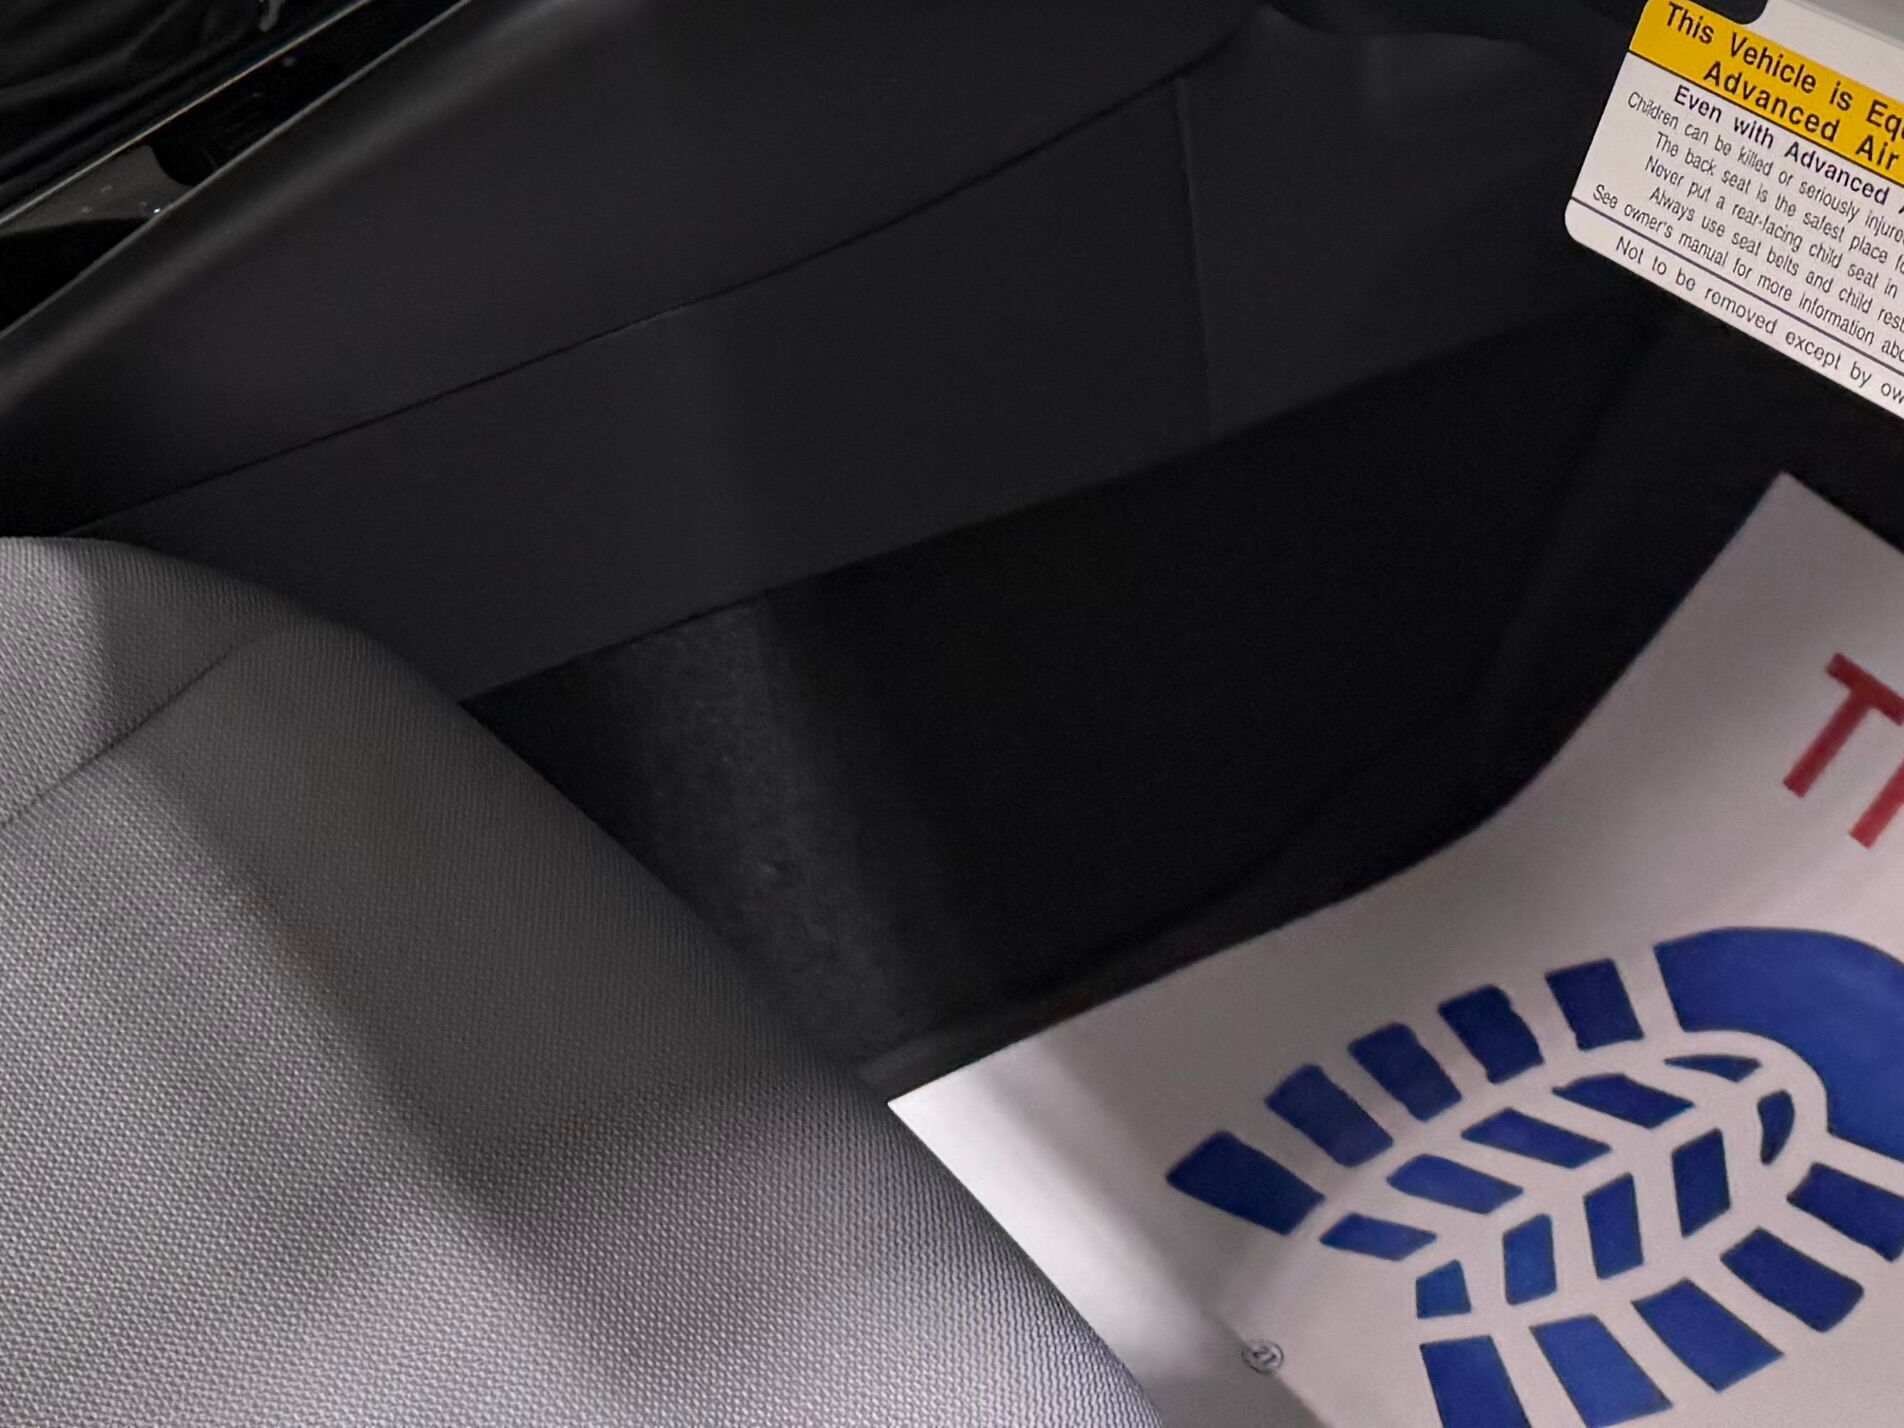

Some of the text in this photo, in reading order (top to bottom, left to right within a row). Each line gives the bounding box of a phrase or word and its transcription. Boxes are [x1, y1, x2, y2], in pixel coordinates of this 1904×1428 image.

[1665, 0, 1715, 45] This
[1729, 30, 1816, 94] Vehicle
[1828, 79, 1853, 112] is
[1701, 59, 1841, 143] Advanced
[1853, 133, 1900, 171] Air
[1626, 90, 1679, 130] Children
[1683, 122, 1709, 145] can
[1713, 133, 1732, 156] be
[1736, 144, 1774, 177] killed
[1777, 169, 1794, 187] or
[1797, 180, 1861, 223] seriously
[1655, 129, 1679, 158] The
[1683, 146, 1717, 176] back
[1720, 169, 1752, 195] seat
[1755, 182, 1769, 203] is
[1773, 192, 1797, 217] the
[1801, 211, 1845, 243] safest
[1847, 234, 1888, 264] place
[1672, 83, 1723, 124] Even
[1732, 115, 1774, 150] with
[1782, 140, 1891, 206] Advanced
[1591, 183, 1618, 209] See
[1623, 203, 1674, 239] owner's
[1677, 231, 1729, 268] manual
[1731, 256, 1753, 280] for
[1755, 273, 1793, 302] more
[1797, 291, 1875, 346] information
[1643, 154, 1685, 187] Never
[1685, 180, 1712, 203] put
[1714, 195, 1726, 210] a
[1730, 202, 1803, 253] rear-facing
[1807, 241, 1843, 269] child
[1846, 262, 1879, 289] seat
[1883, 277, 1898, 300] in
[1648, 185, 1695, 222] Always
[1700, 214, 1726, 238] use
[1730, 231, 1762, 257] seat
[1765, 245, 1800, 277] belts
[1804, 269, 1834, 294] and
[1837, 285, 1873, 314] child
[1614, 234, 1644, 265] Not
[1651, 254, 1667, 276] to
[1674, 266, 1696, 292] be
[1703, 286, 1778, 335] removed
[1784, 330, 1841, 370] except
[1849, 359, 1872, 388] by
